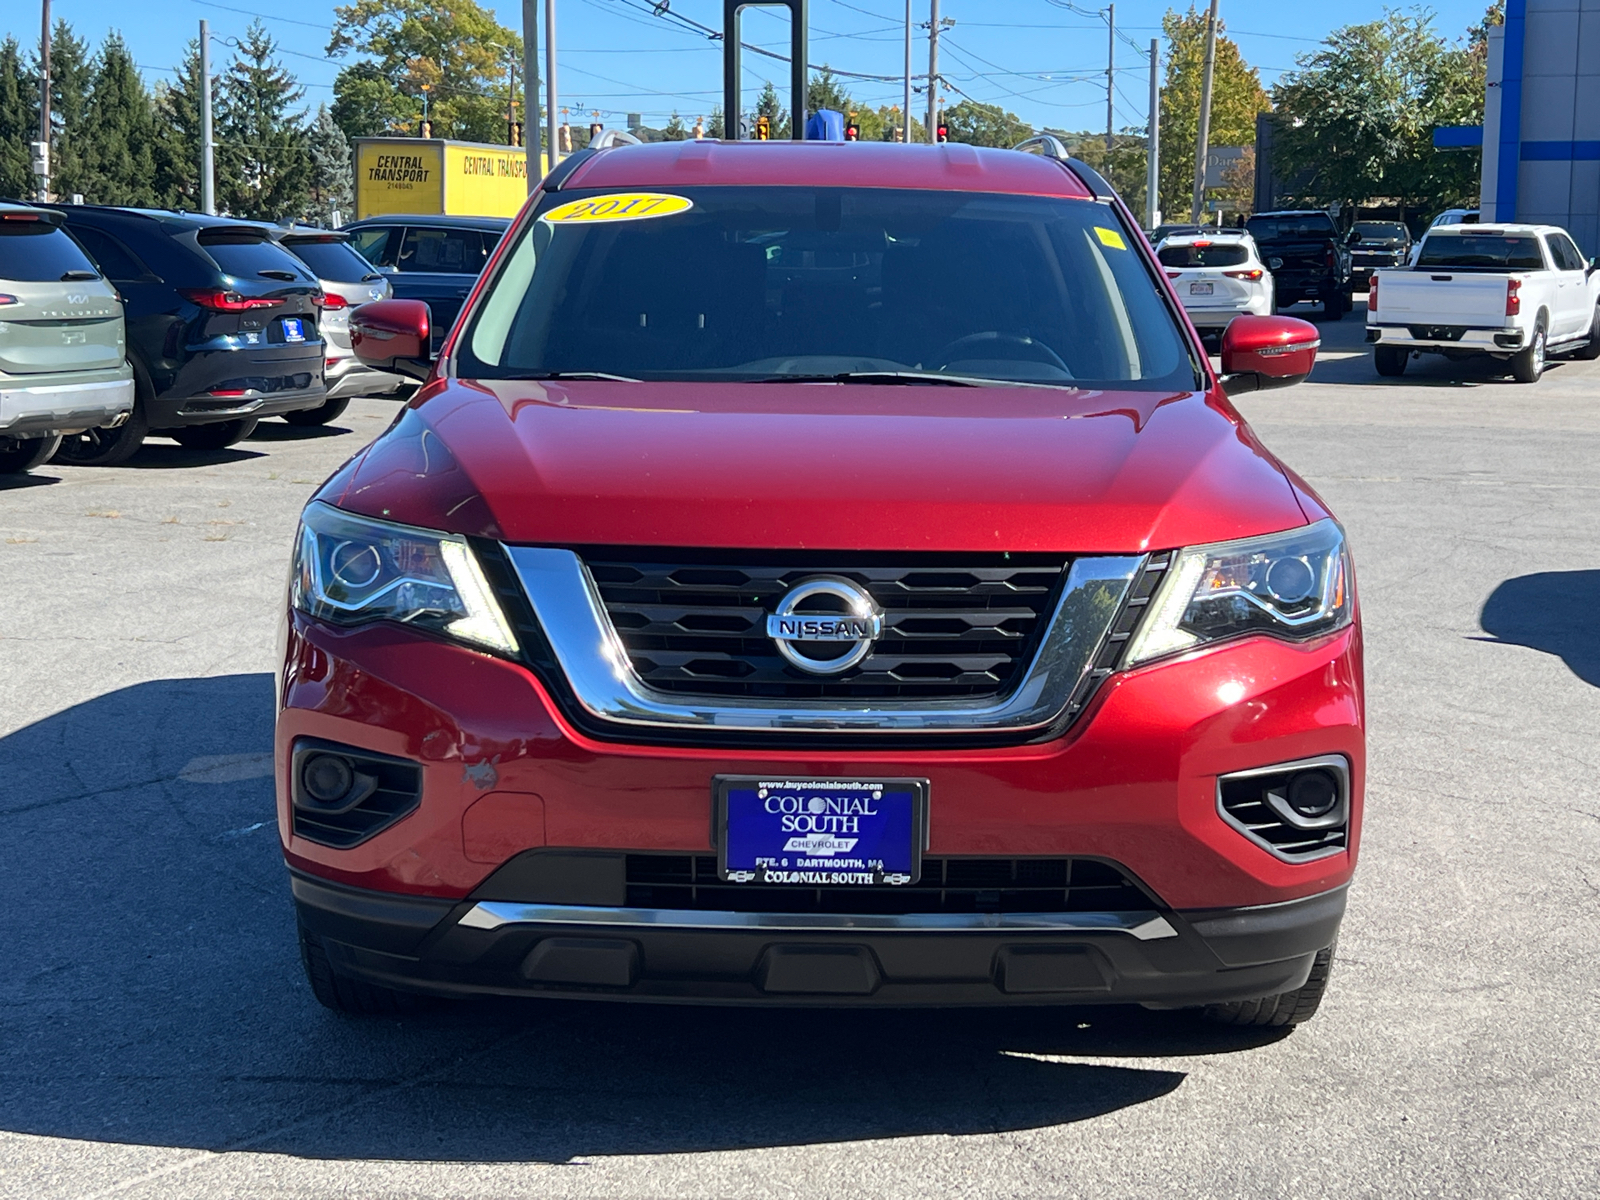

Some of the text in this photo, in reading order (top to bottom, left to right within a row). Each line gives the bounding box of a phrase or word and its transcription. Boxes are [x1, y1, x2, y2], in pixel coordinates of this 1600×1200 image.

[377, 155, 423, 169] CENTRAL
[463, 156, 528, 179] CENTRAL TRANSPO
[368, 168, 430, 183] TRANSPORT
[562, 198, 667, 220] 2017
[67, 294, 90, 304] KIA
[41, 309, 111, 317] TELLURIDE
[779, 620, 867, 635] NISSAN
[758, 780, 883, 791] www.buycolonialsouth.com
[764, 796, 878, 815] COLONIAL
[781, 815, 860, 833] SOUTH
[791, 839, 850, 849] CHEVROLET
[781, 857, 789, 868] 6
[796, 858, 866, 870] DARTMOUTH,
[868, 859, 884, 869] MA
[764, 870, 874, 885] COLONIAL SOUTH
